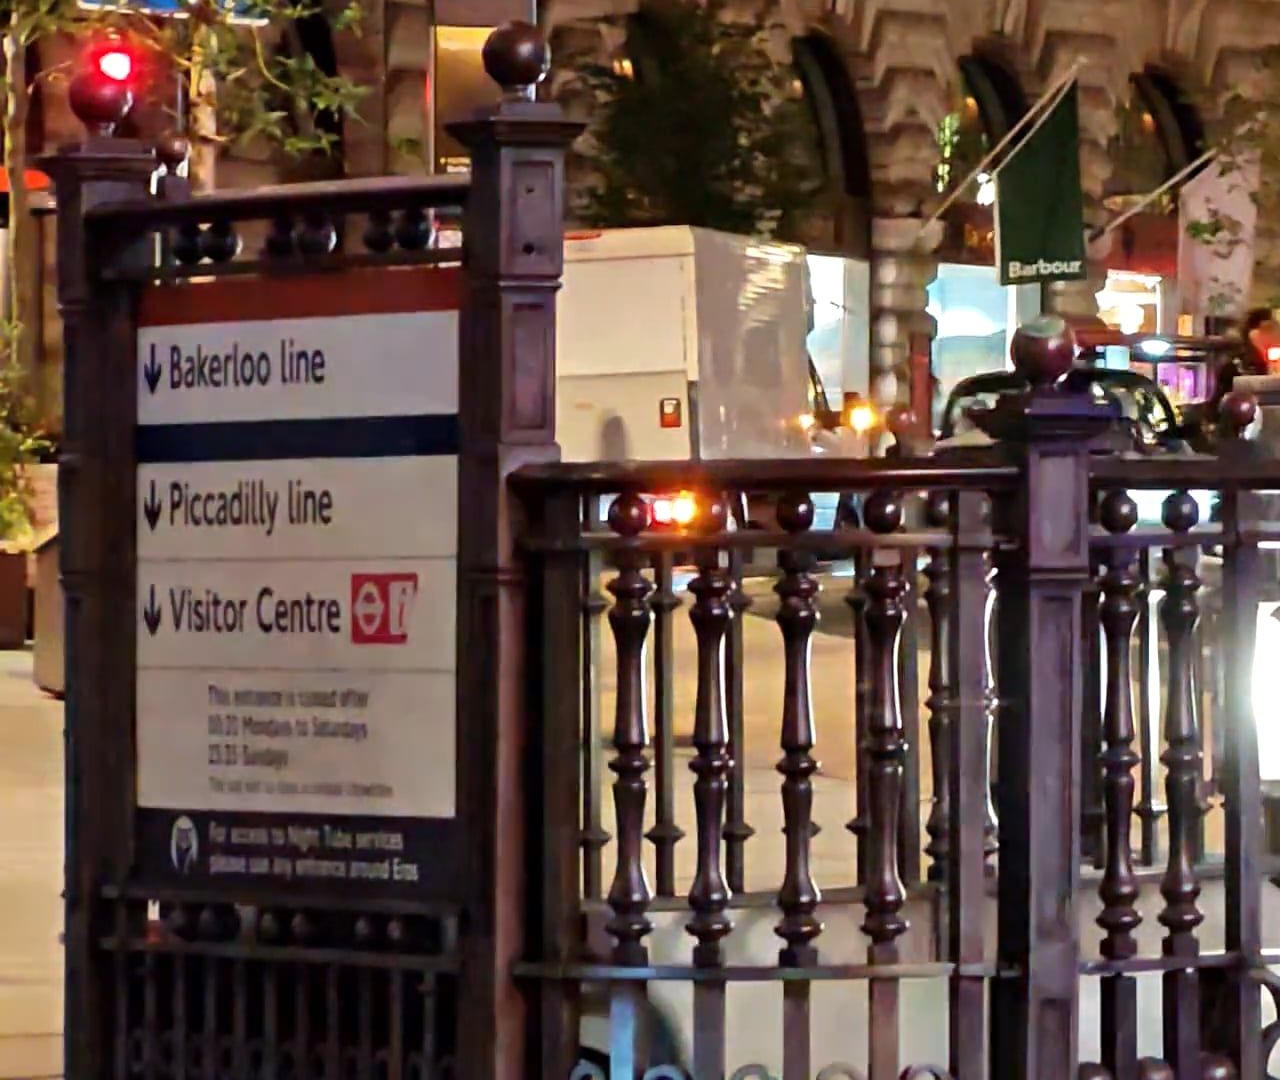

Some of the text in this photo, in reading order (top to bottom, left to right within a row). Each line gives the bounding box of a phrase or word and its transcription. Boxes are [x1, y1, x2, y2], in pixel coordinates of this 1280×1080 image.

[1008, 258, 1083, 279] Barbour
[168, 338, 326, 391] Bakerloo line
[168, 478, 334, 537] Piccadilly line
[168, 586, 248, 634] Visitor
[255, 586, 342, 634] Centre
